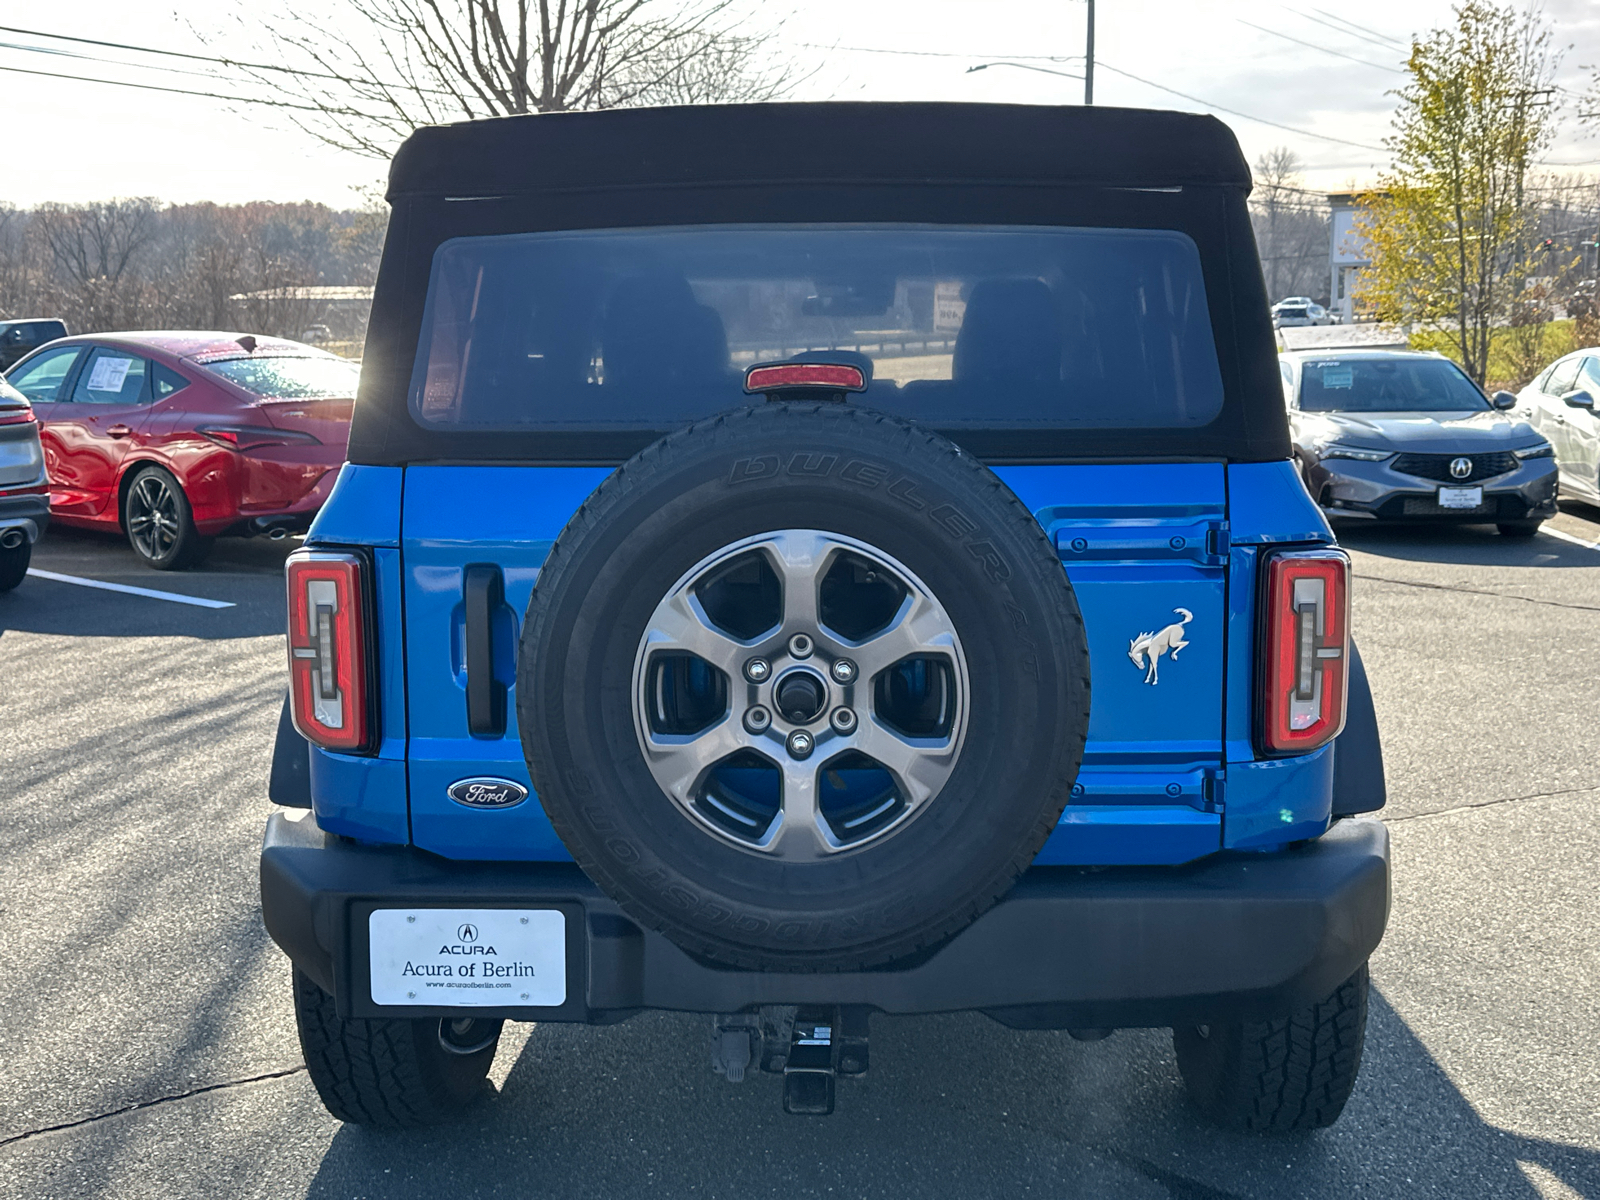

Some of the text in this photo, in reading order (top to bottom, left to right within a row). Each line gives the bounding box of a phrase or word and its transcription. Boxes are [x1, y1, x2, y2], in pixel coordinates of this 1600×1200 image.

[727, 452, 1013, 584] DUELER
[465, 783, 509, 802] Ford
[438, 945, 498, 956] ACURA
[402, 961, 535, 977] Acura of Berlin
[425, 981, 512, 989] www.acuraofberlin.com
